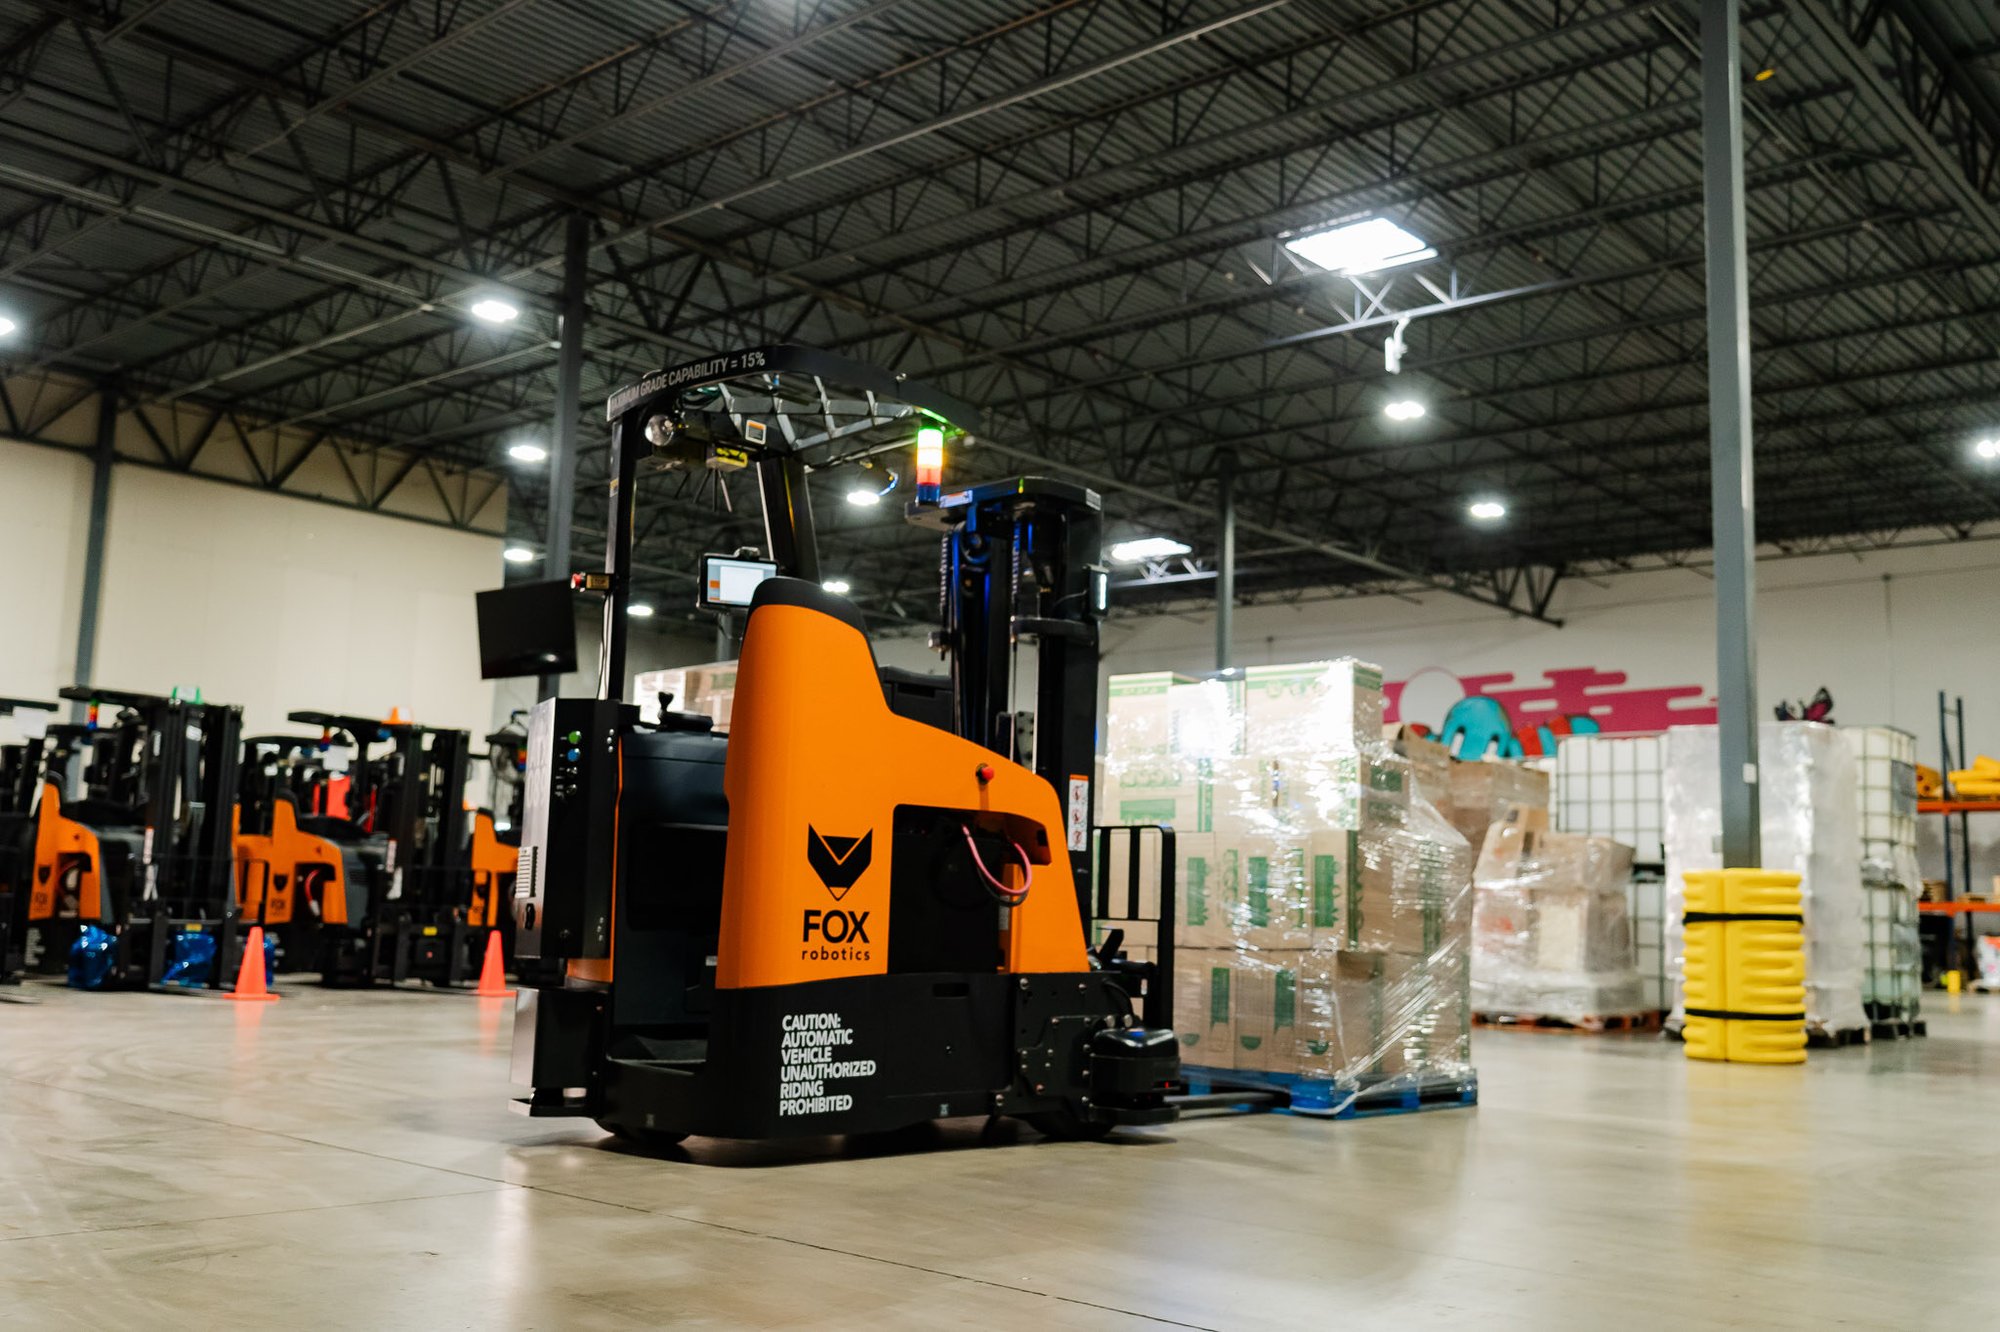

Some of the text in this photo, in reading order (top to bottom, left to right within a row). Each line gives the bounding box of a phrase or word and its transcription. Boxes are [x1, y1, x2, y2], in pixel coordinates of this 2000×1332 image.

[640, 374, 668, 396] GRADE
[668, 357, 728, 385] CAPABILITY
[731, 360, 738, 368] =
[741, 351, 765, 369] 15%
[803, 910, 870, 943] FOX
[801, 945, 870, 961] robotics
[782, 1013, 841, 1031] CAUTION:
[781, 1029, 853, 1048] AUTOMATIC
[781, 1047, 832, 1065] VEHICLE
[781, 1060, 876, 1082] UNAUTHORIZED
[780, 1081, 824, 1099] RIDING
[779, 1095, 853, 1116] PROHIBITED
